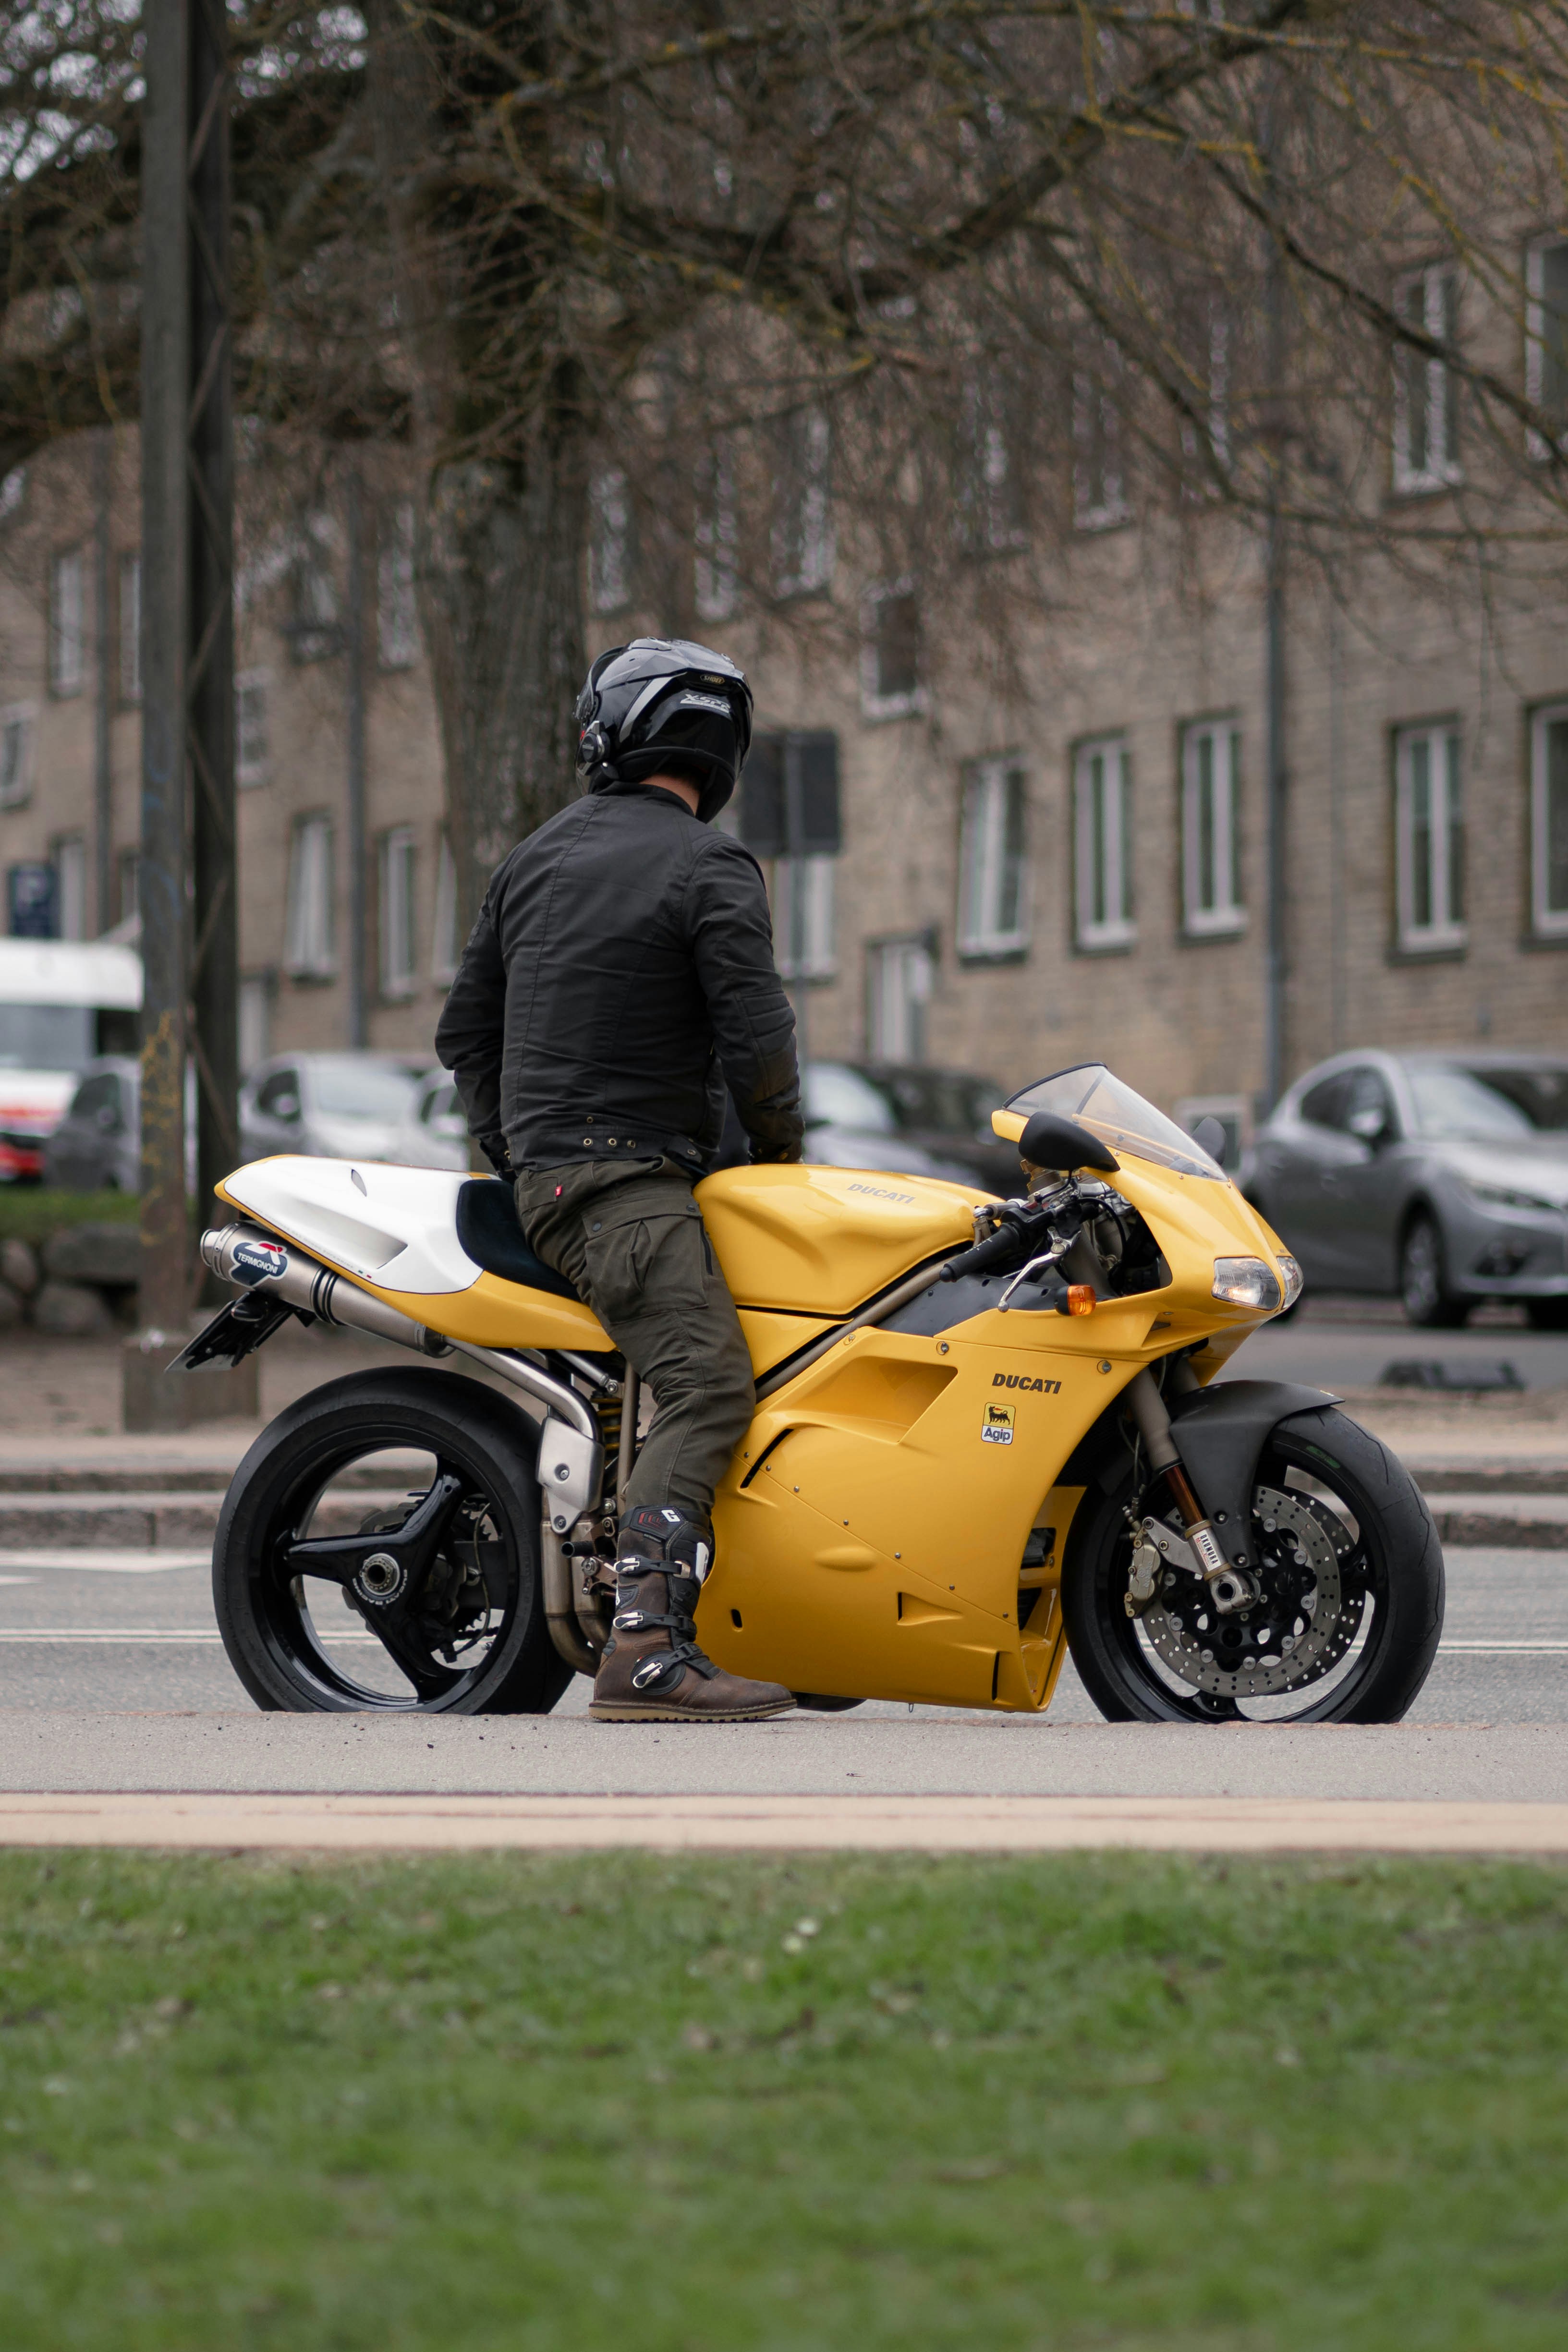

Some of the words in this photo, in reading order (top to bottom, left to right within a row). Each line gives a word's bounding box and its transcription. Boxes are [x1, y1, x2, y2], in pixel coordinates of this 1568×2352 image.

[703, 675, 722, 683] SHOEI
[847, 1184, 916, 1204] DUCATI
[238, 1252, 278, 1273] TERMIGNONI
[992, 1373, 1062, 1394] DUCATI
[984, 1427, 1010, 1442] Agip
[1200, 1534, 1218, 1564] OKUMURA
